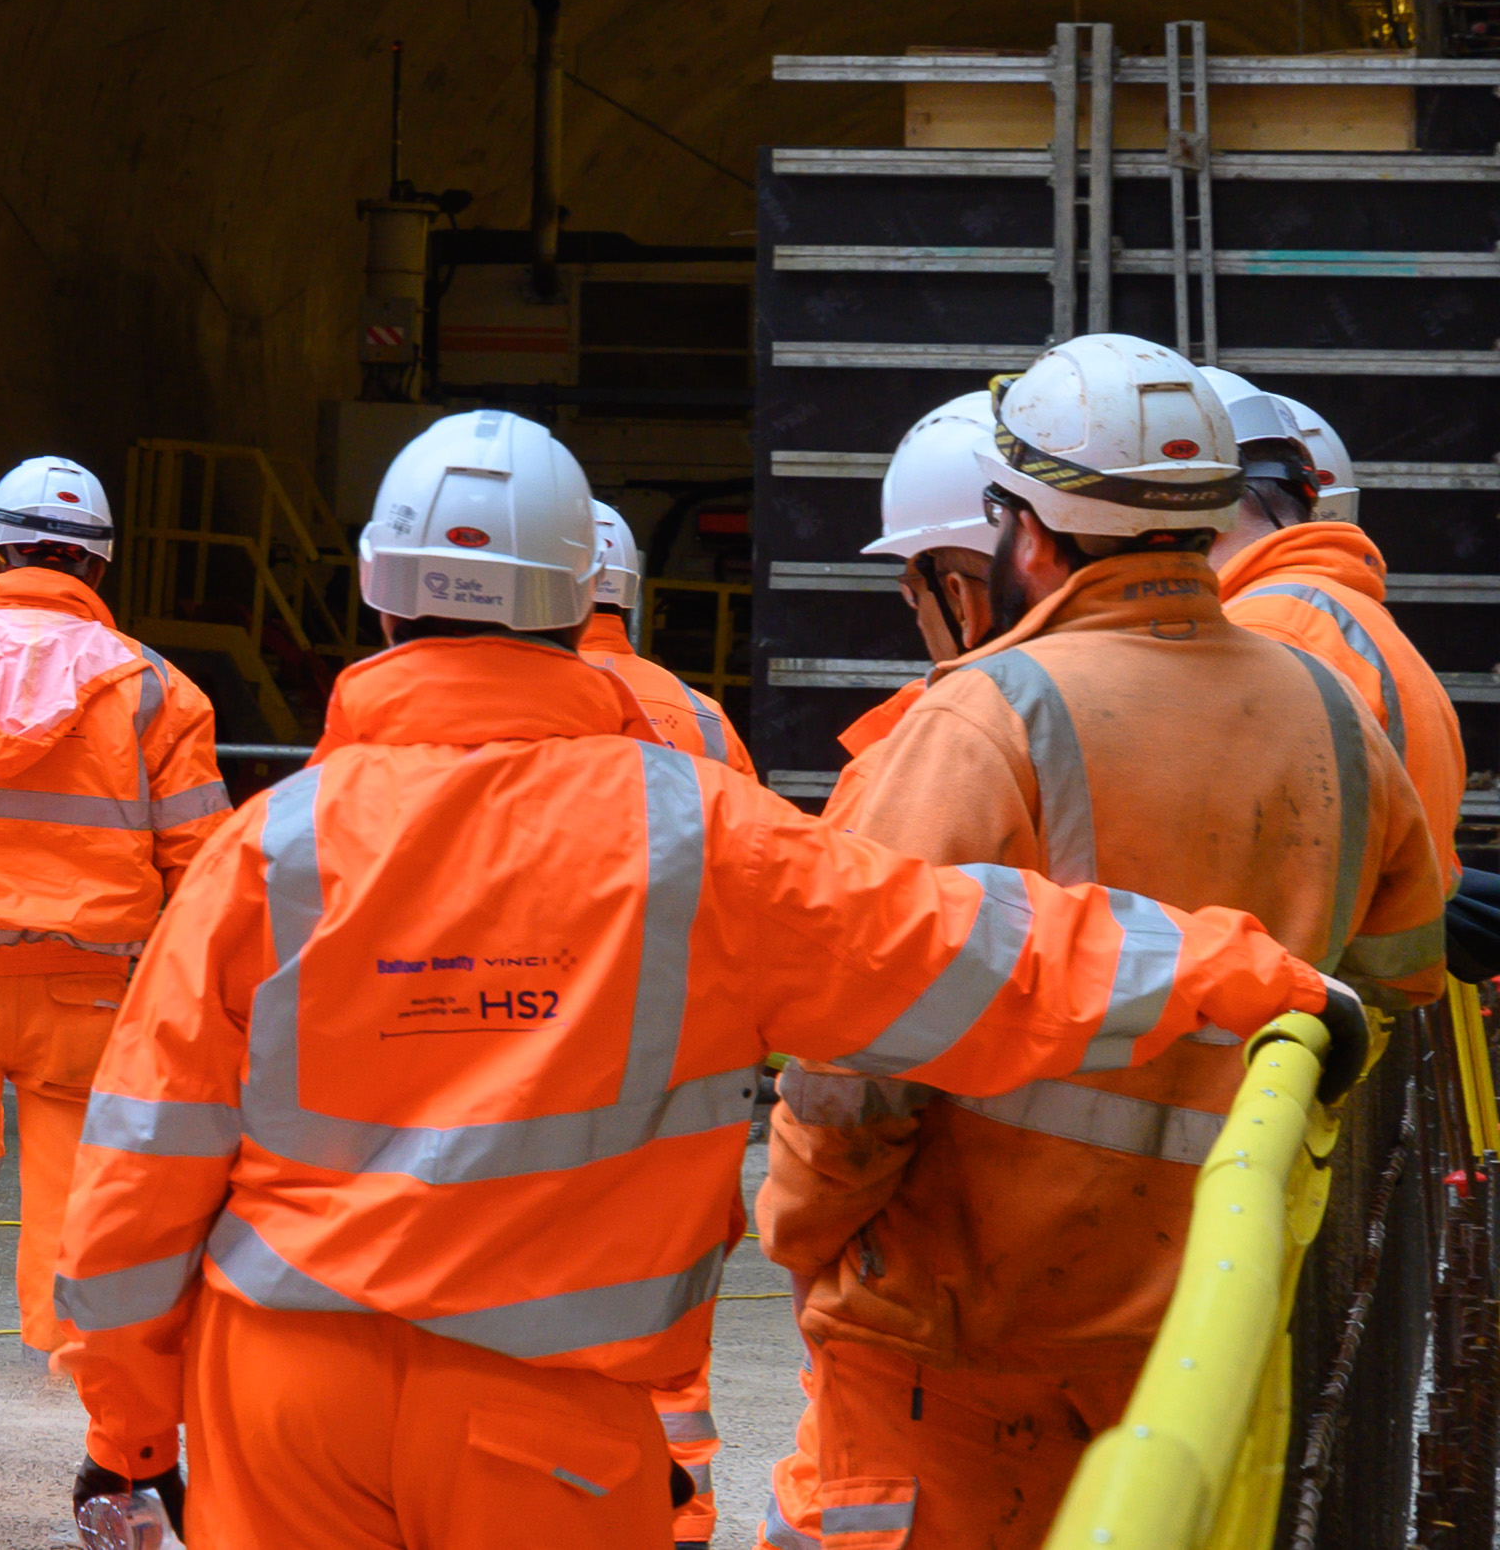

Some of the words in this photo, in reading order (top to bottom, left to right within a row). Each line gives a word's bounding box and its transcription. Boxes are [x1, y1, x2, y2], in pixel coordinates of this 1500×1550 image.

[454, 577, 484, 592] Safe
[454, 592, 467, 602] at
[468, 592, 504, 606] heart
[484, 957, 548, 967] VINCI
[479, 990, 560, 1020] HS2
